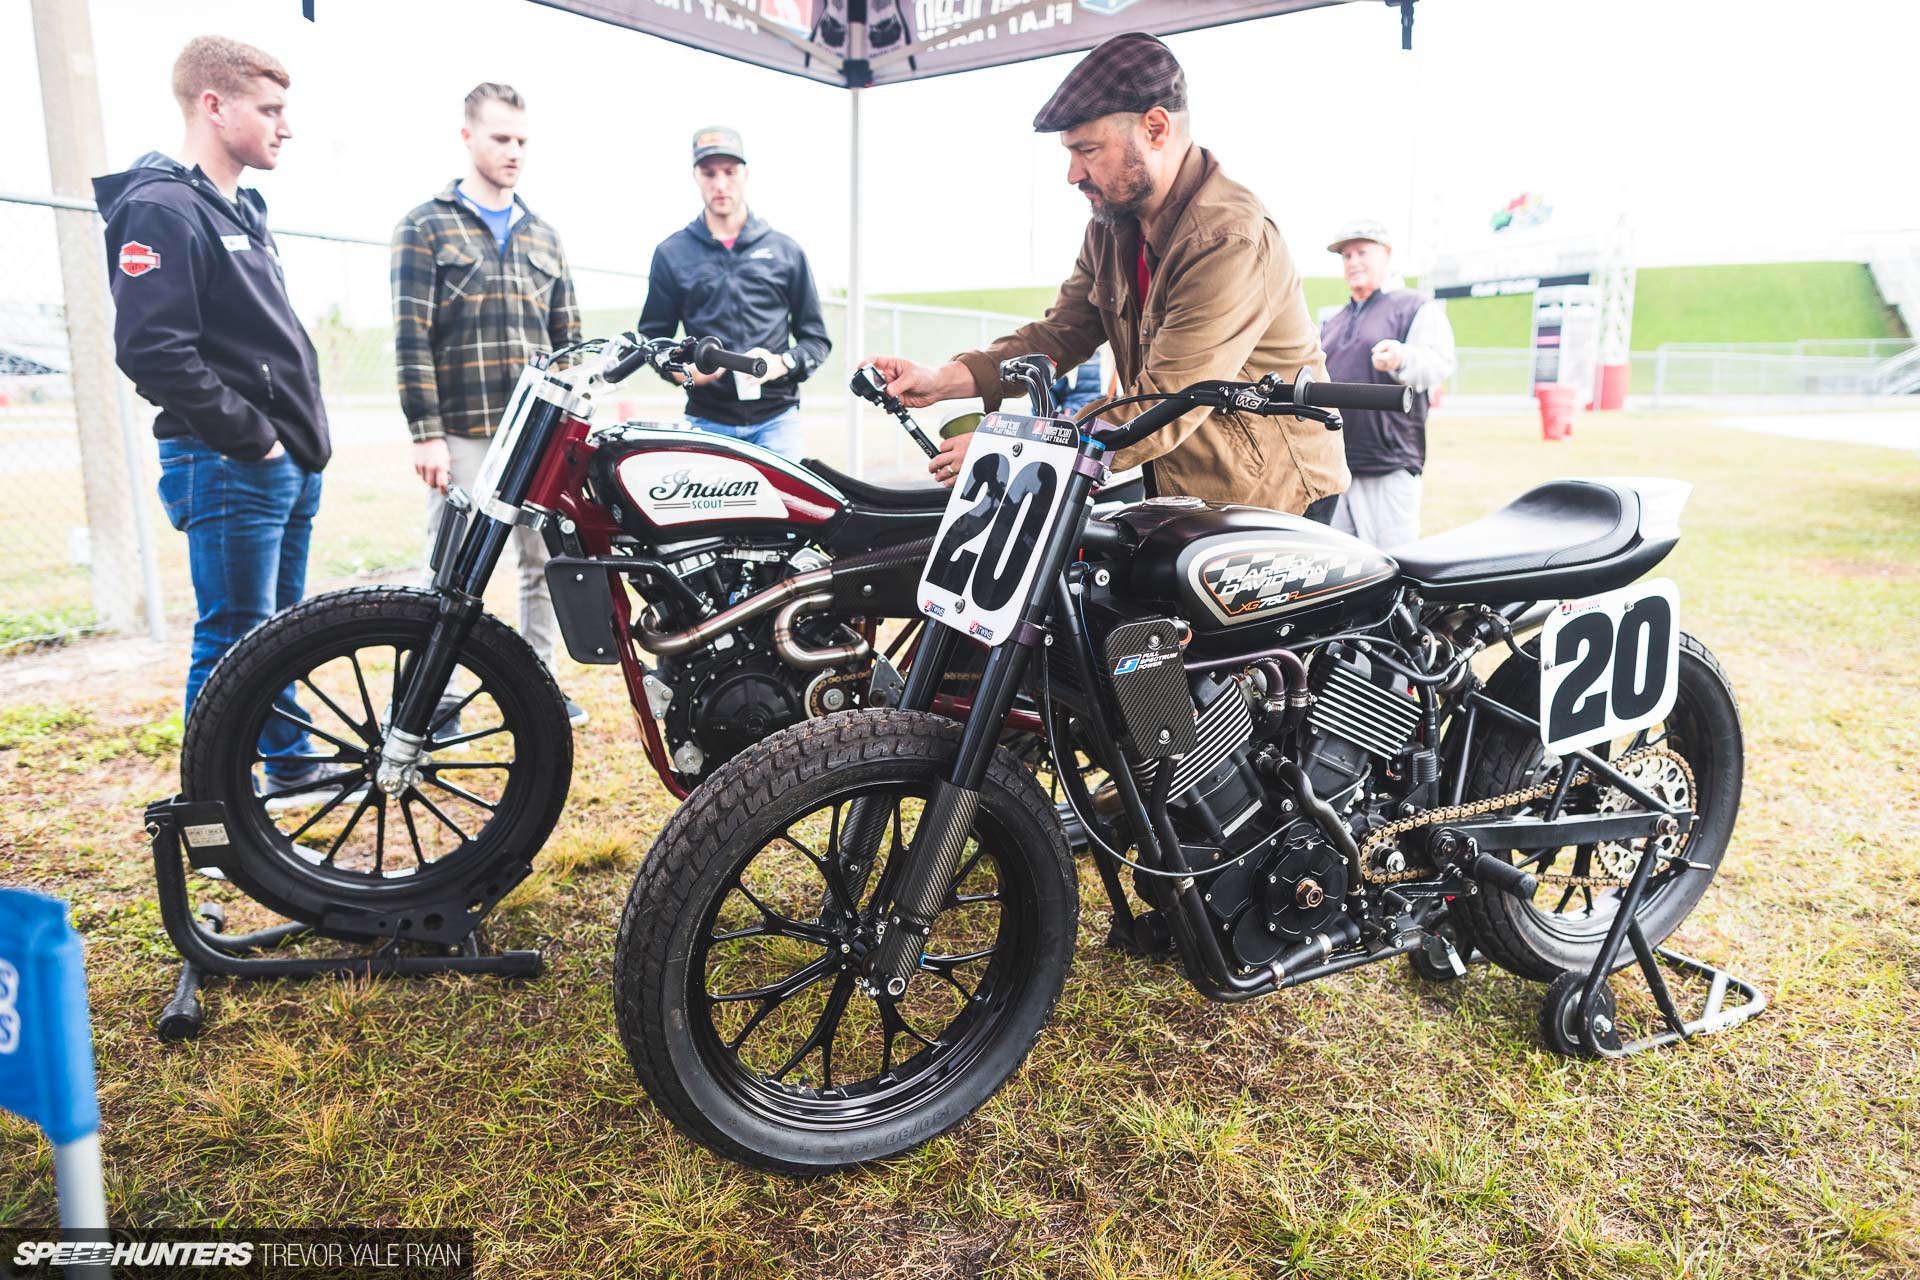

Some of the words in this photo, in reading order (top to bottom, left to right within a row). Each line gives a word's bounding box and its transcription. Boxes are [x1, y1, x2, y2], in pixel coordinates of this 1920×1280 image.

[1041, 434, 1053, 442] FLAT
[1053, 436, 1070, 444] TRACK
[649, 469, 758, 500] Indian
[691, 499, 723, 509] SCOUT
[925, 453, 1058, 611] 20
[1220, 563, 1330, 595] DAVIDSON
[1240, 591, 1300, 611] XG750R
[1140, 652, 1178, 665] SPECTRUM
[1142, 651, 1159, 659] FULL
[1137, 661, 1163, 670] POWER
[1548, 595, 1671, 744] 20
